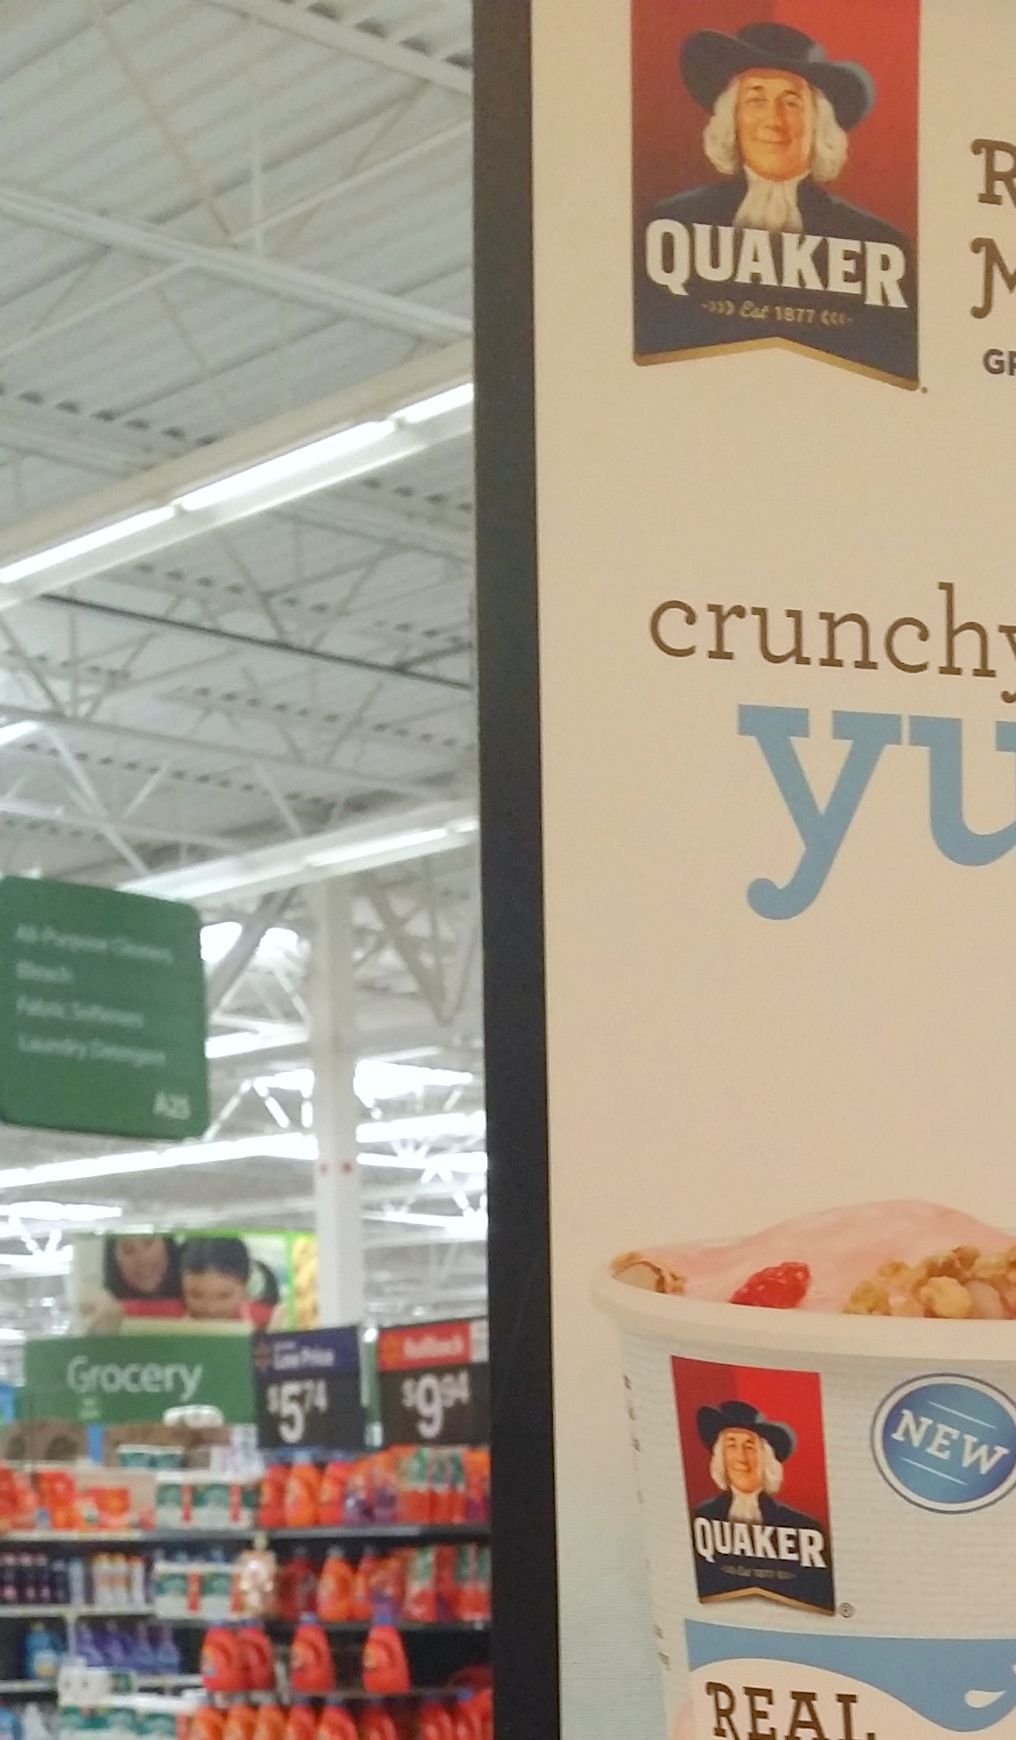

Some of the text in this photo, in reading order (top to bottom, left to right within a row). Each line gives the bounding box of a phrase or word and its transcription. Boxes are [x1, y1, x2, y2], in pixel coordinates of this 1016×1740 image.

[646, 218, 909, 309] QUAKER
[67, 1355, 203, 1400] Grocery
[891, 1408, 1010, 1475] NEW
[693, 1517, 828, 1568] QUAKER
